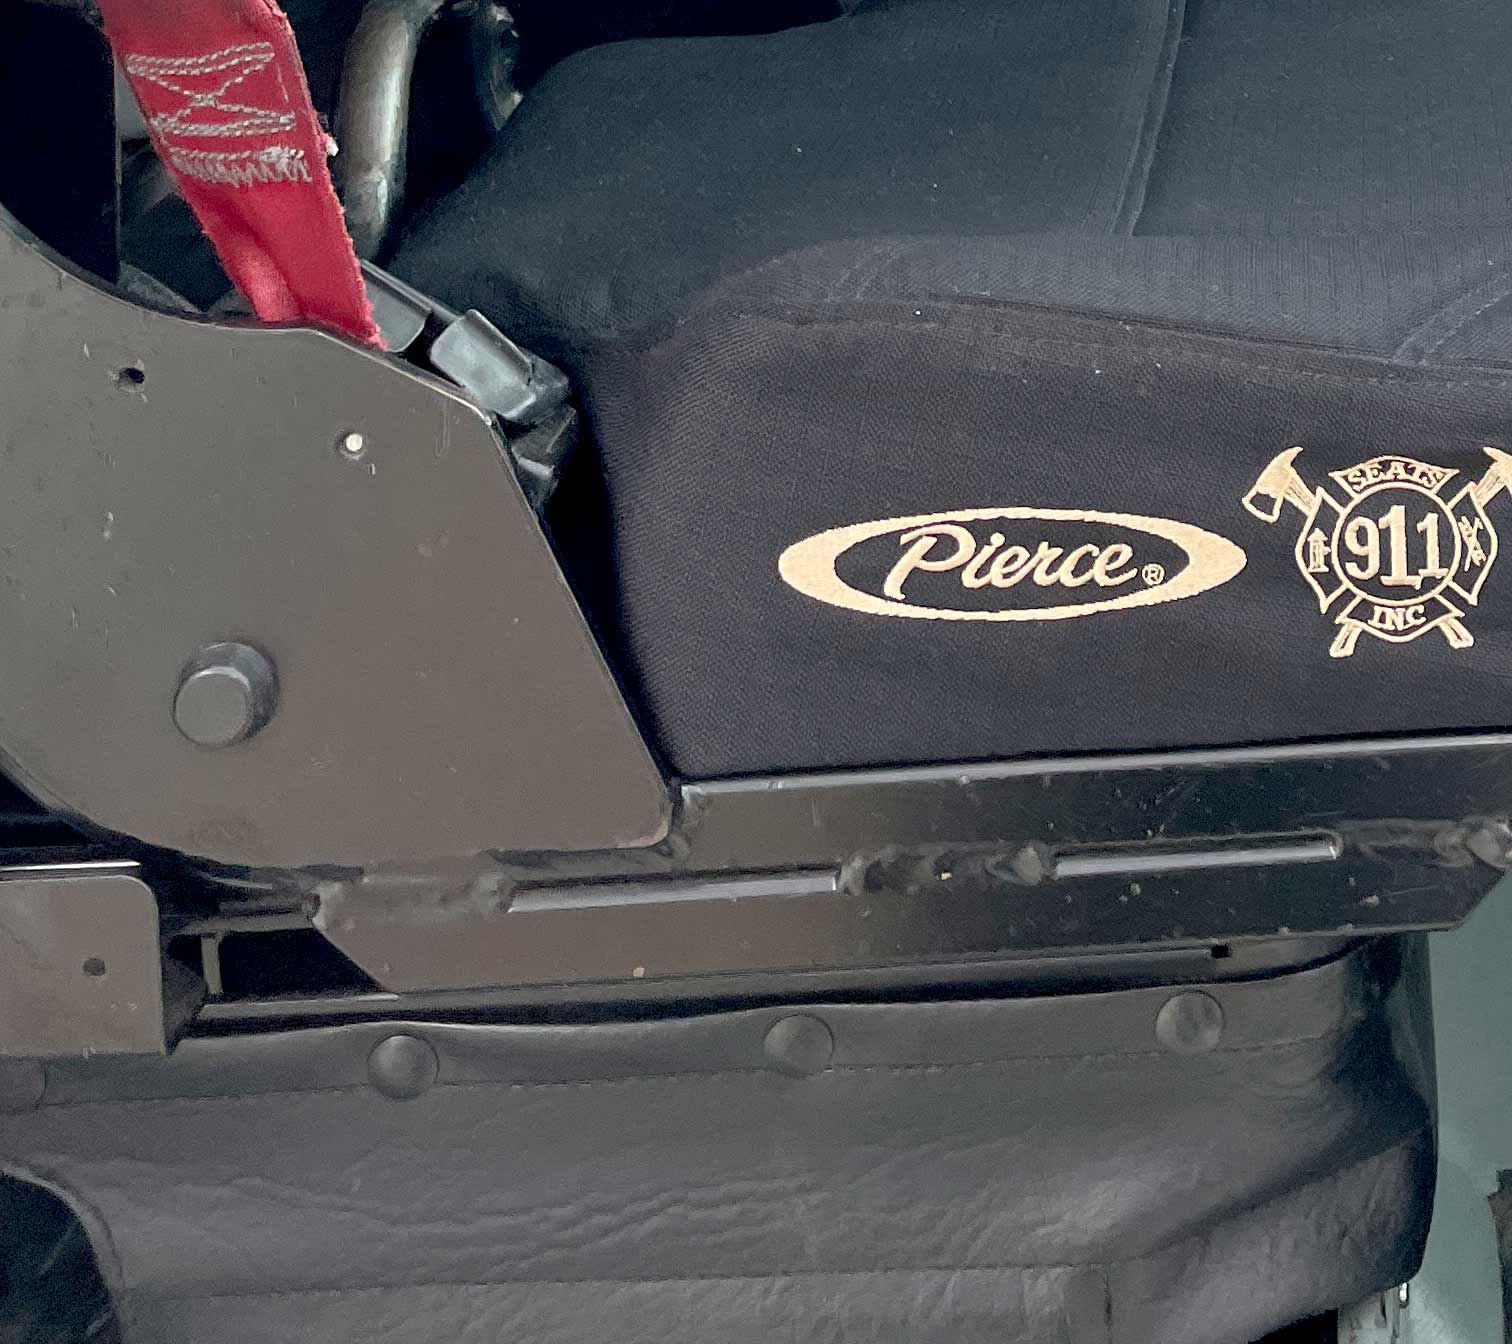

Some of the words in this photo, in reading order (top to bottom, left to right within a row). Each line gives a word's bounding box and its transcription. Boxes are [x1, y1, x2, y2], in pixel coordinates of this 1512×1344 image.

[1347, 461, 1444, 493] SEATS
[1344, 504, 1450, 590] 911
[1367, 603, 1427, 631] INC
